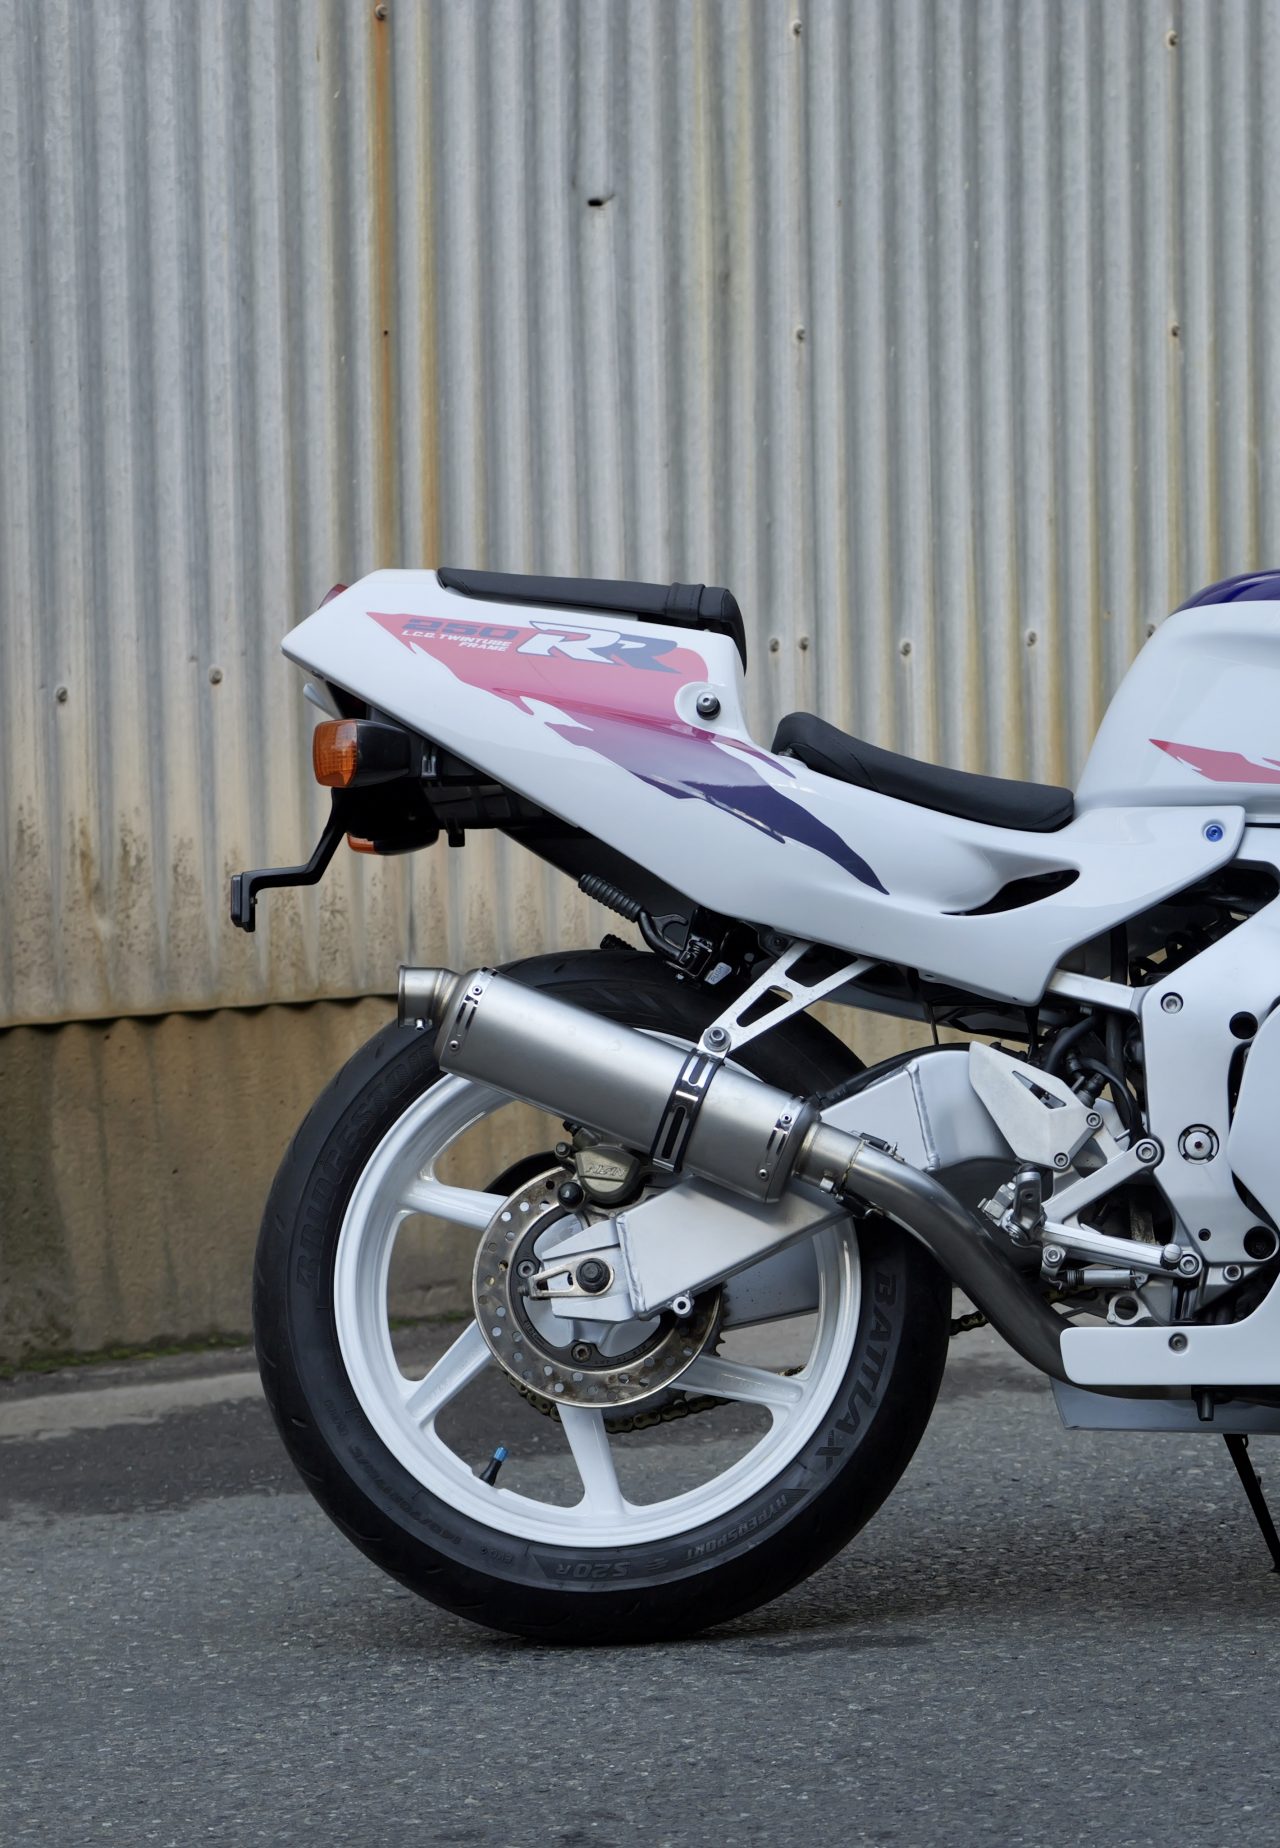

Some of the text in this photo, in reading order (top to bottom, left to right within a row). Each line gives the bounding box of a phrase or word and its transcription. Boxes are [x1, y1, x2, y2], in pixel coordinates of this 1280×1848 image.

[402, 619, 682, 674] 250 RR
[439, 633, 512, 647] TWINTUBE
[458, 641, 508, 652] FRAME
[296, 1042, 437, 1290] BRIDGESTON
[814, 1272, 897, 1472] BATTLAX
